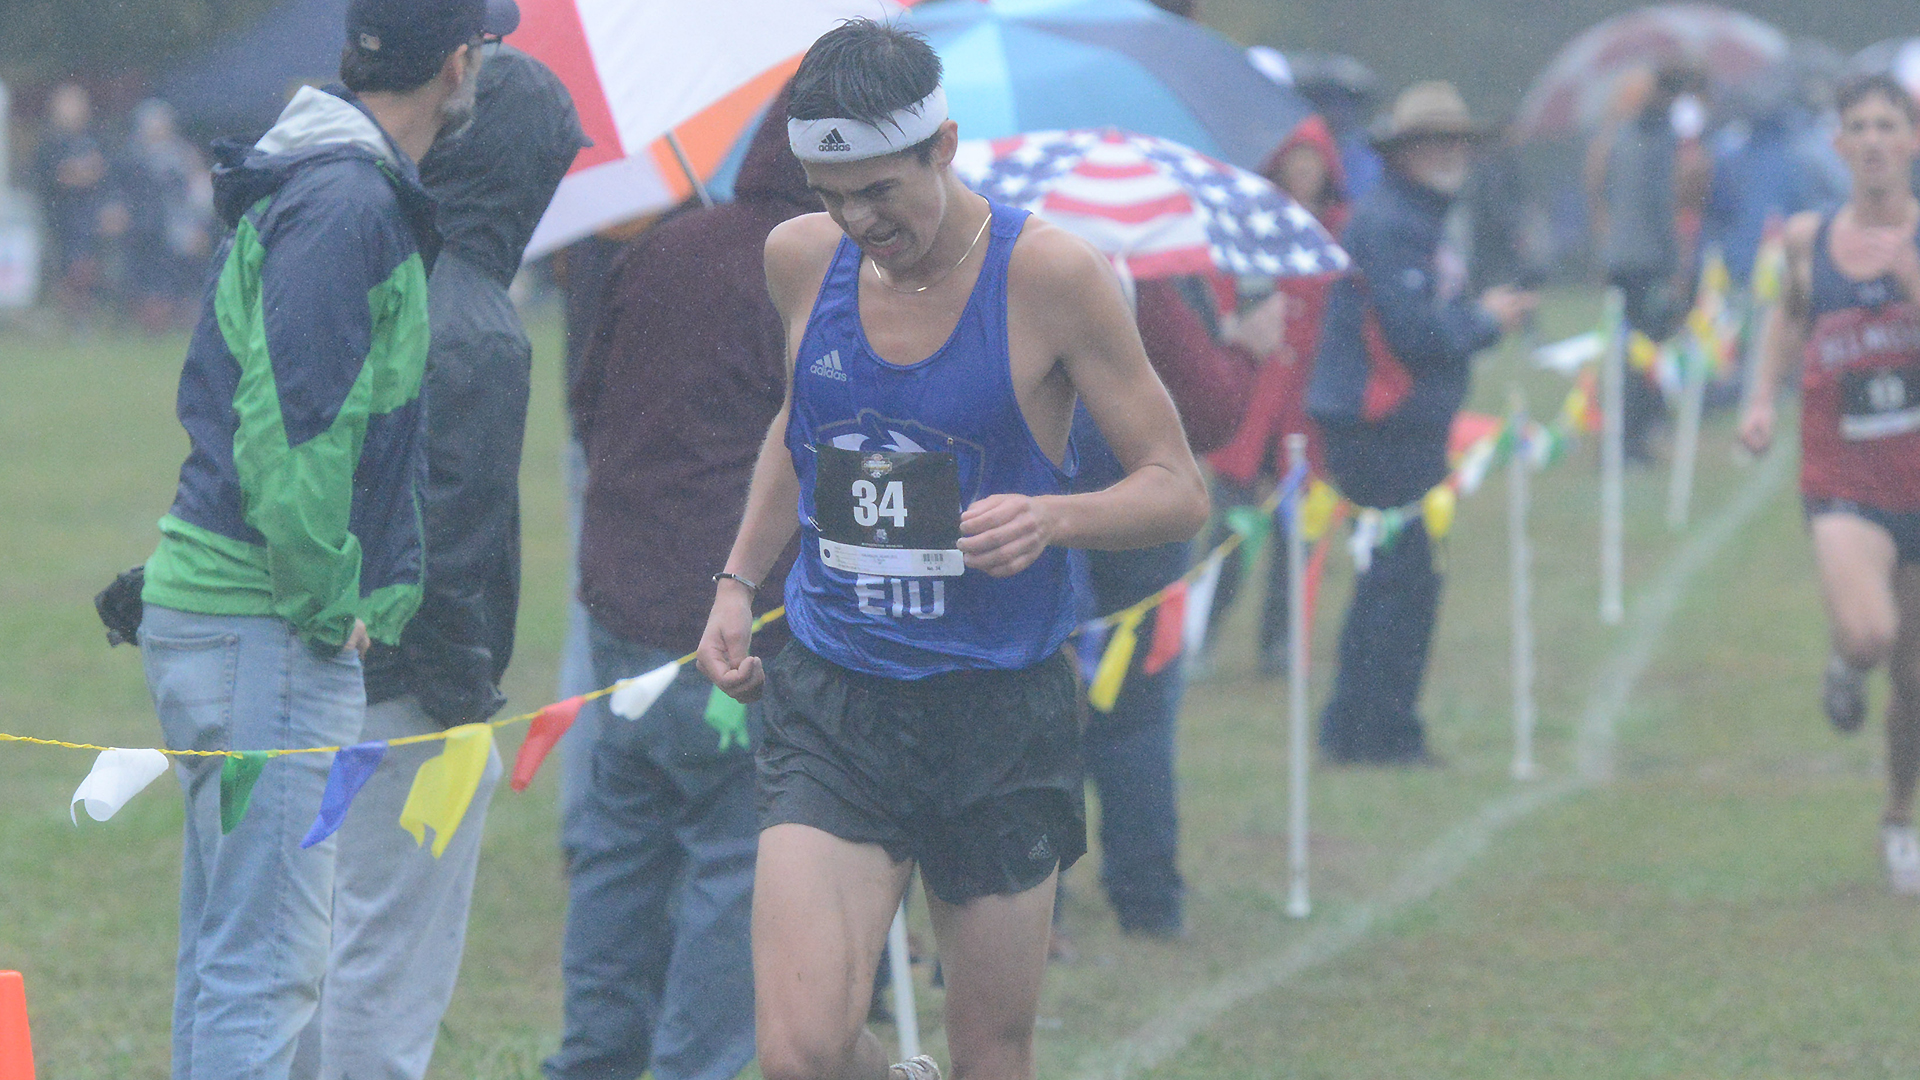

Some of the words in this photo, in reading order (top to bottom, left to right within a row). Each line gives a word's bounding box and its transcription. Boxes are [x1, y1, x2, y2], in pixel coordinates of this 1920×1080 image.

[818, 142, 851, 152] adidas
[810, 363, 847, 382] adidas
[851, 479, 908, 528] 34
[854, 573, 945, 620] EIU
